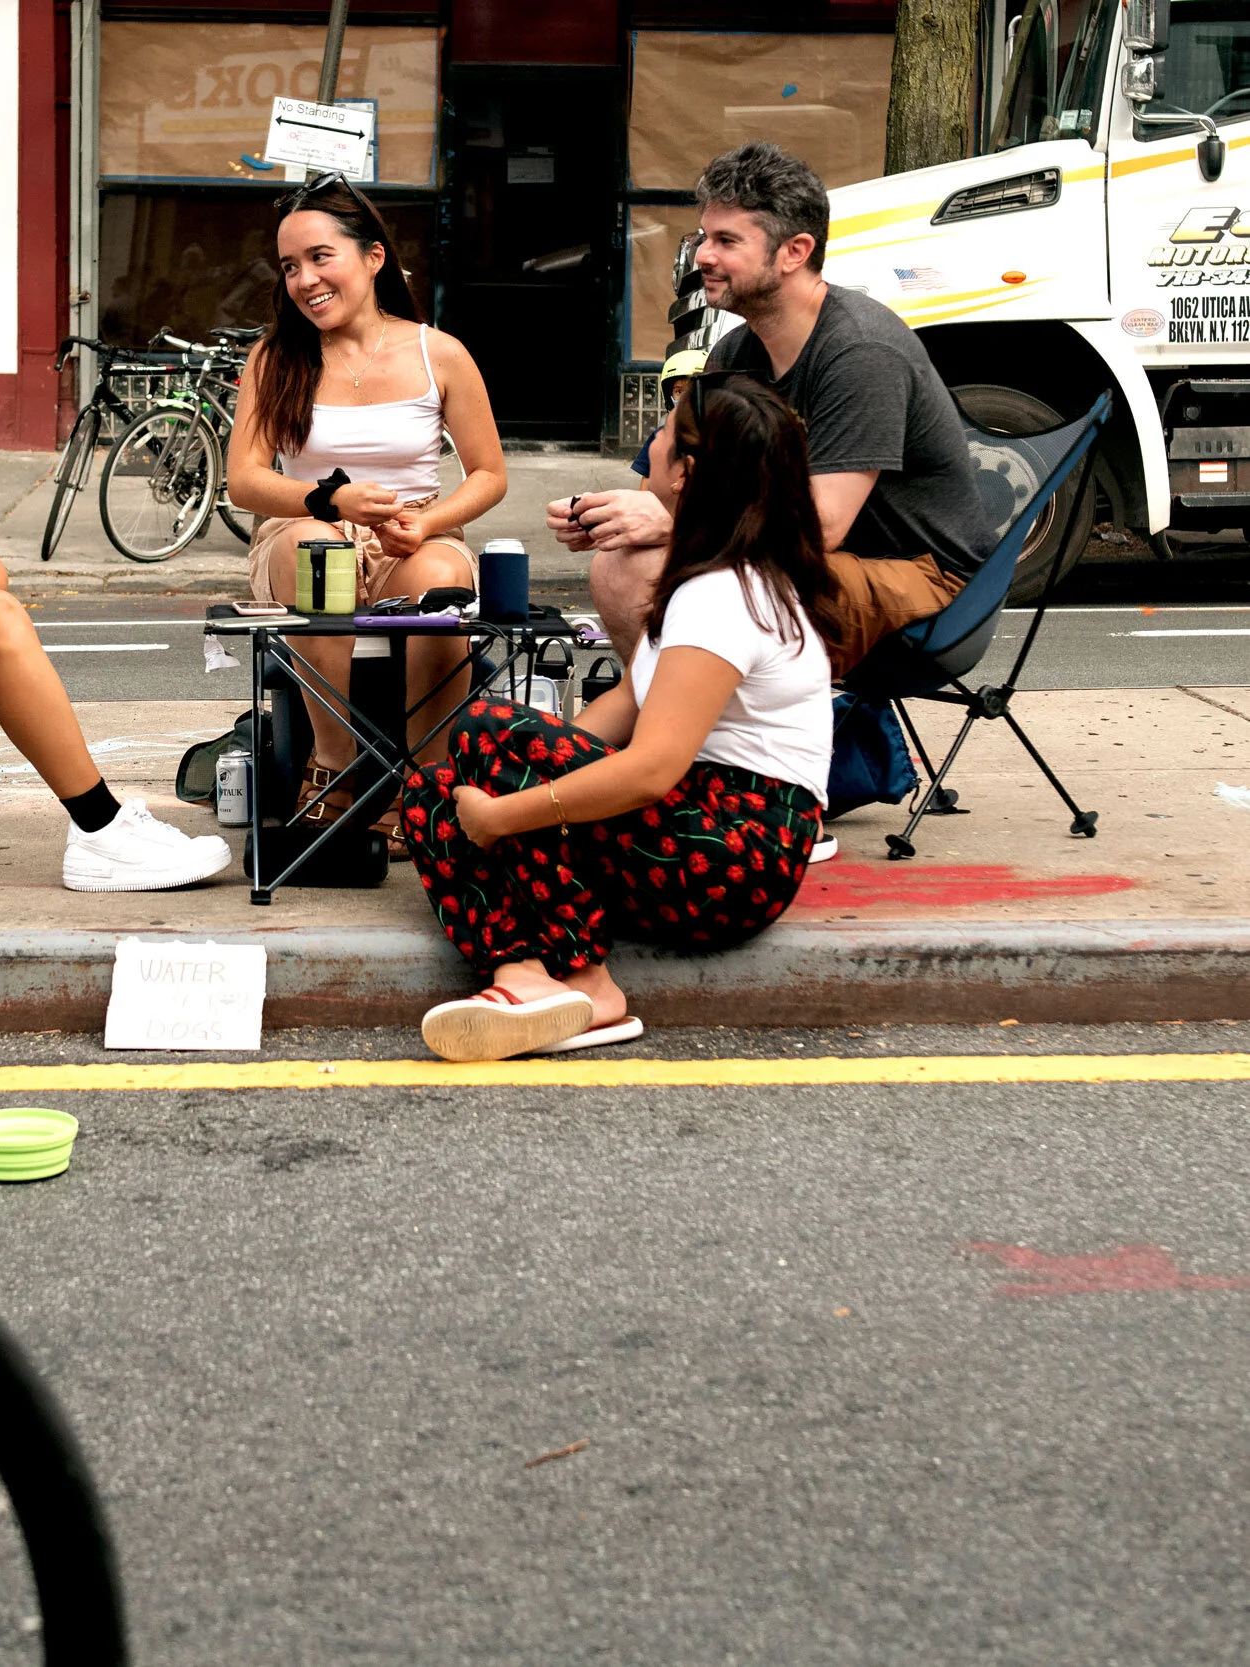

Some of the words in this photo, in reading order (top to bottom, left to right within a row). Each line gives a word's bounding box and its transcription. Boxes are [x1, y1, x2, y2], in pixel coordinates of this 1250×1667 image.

[278, 100, 294, 112] No
[297, 103, 346, 123] Standing
[1170, 296, 1199, 319] 1062
[1202, 296, 1236, 319] UTICA
[1169, 321, 1207, 343] BKLYN.
[1209, 320, 1228, 342] N.Y.
[1231, 320, 1250, 342] 112
[140, 959, 226, 984] WATER
[146, 1018, 223, 1041] DOGS
